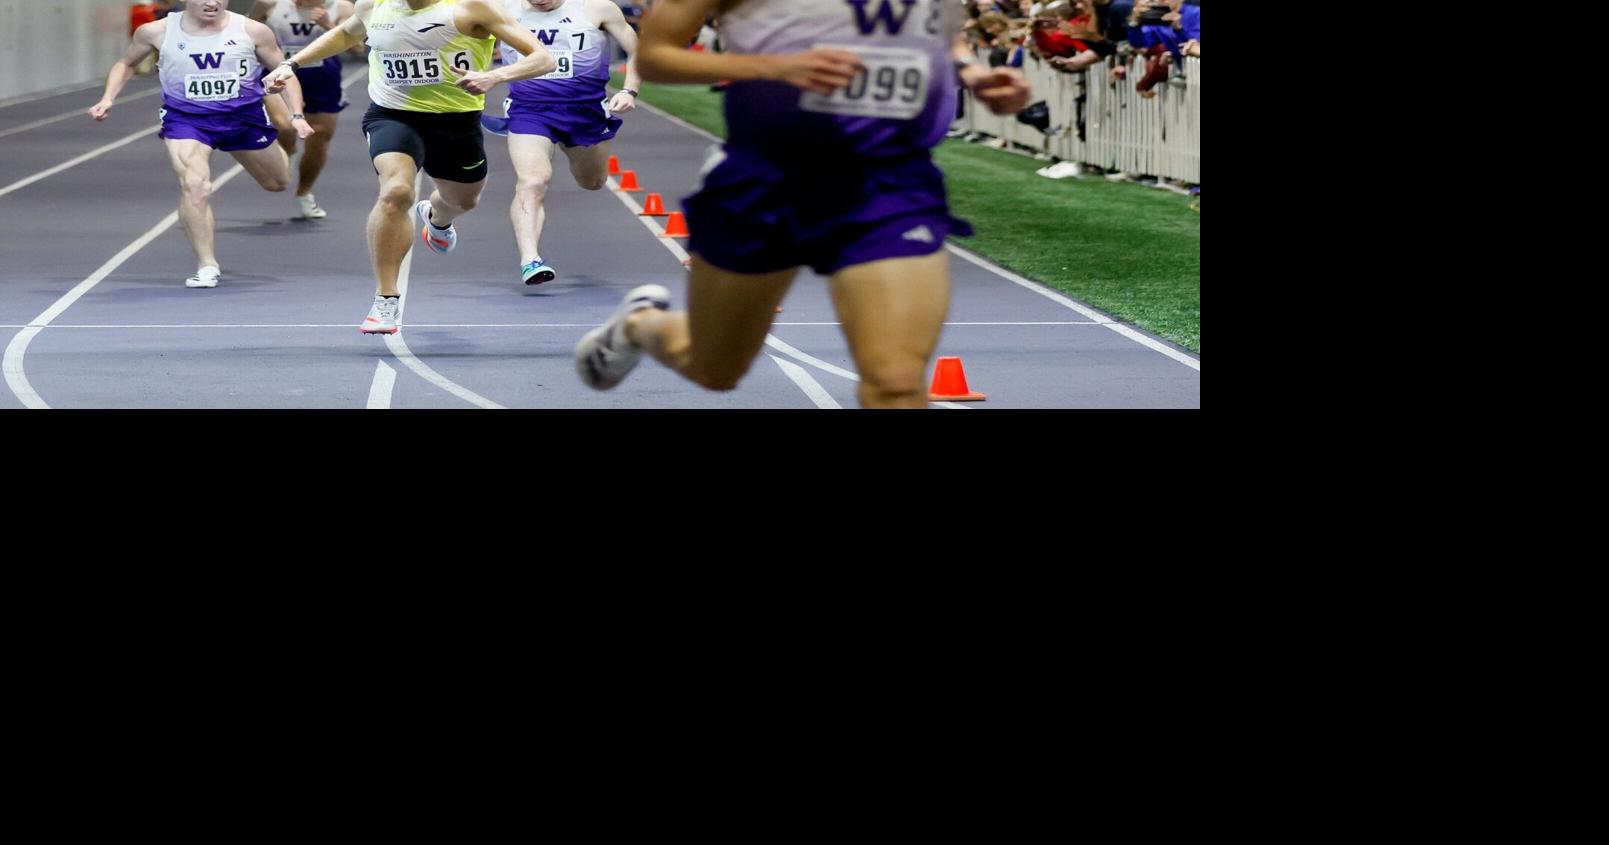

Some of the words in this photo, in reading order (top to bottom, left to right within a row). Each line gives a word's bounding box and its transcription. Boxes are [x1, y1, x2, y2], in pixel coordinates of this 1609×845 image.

[843, 0, 916, 36] W
[289, 22, 316, 36] W
[571, 32, 585, 50] 7
[189, 51, 226, 70] W
[383, 51, 432, 59] WASHINGTON
[454, 51, 470, 71] 6
[239, 59, 248, 77] 5
[382, 58, 440, 79] 3915
[188, 79, 237, 96] 4097
[844, 66, 922, 103] 099
